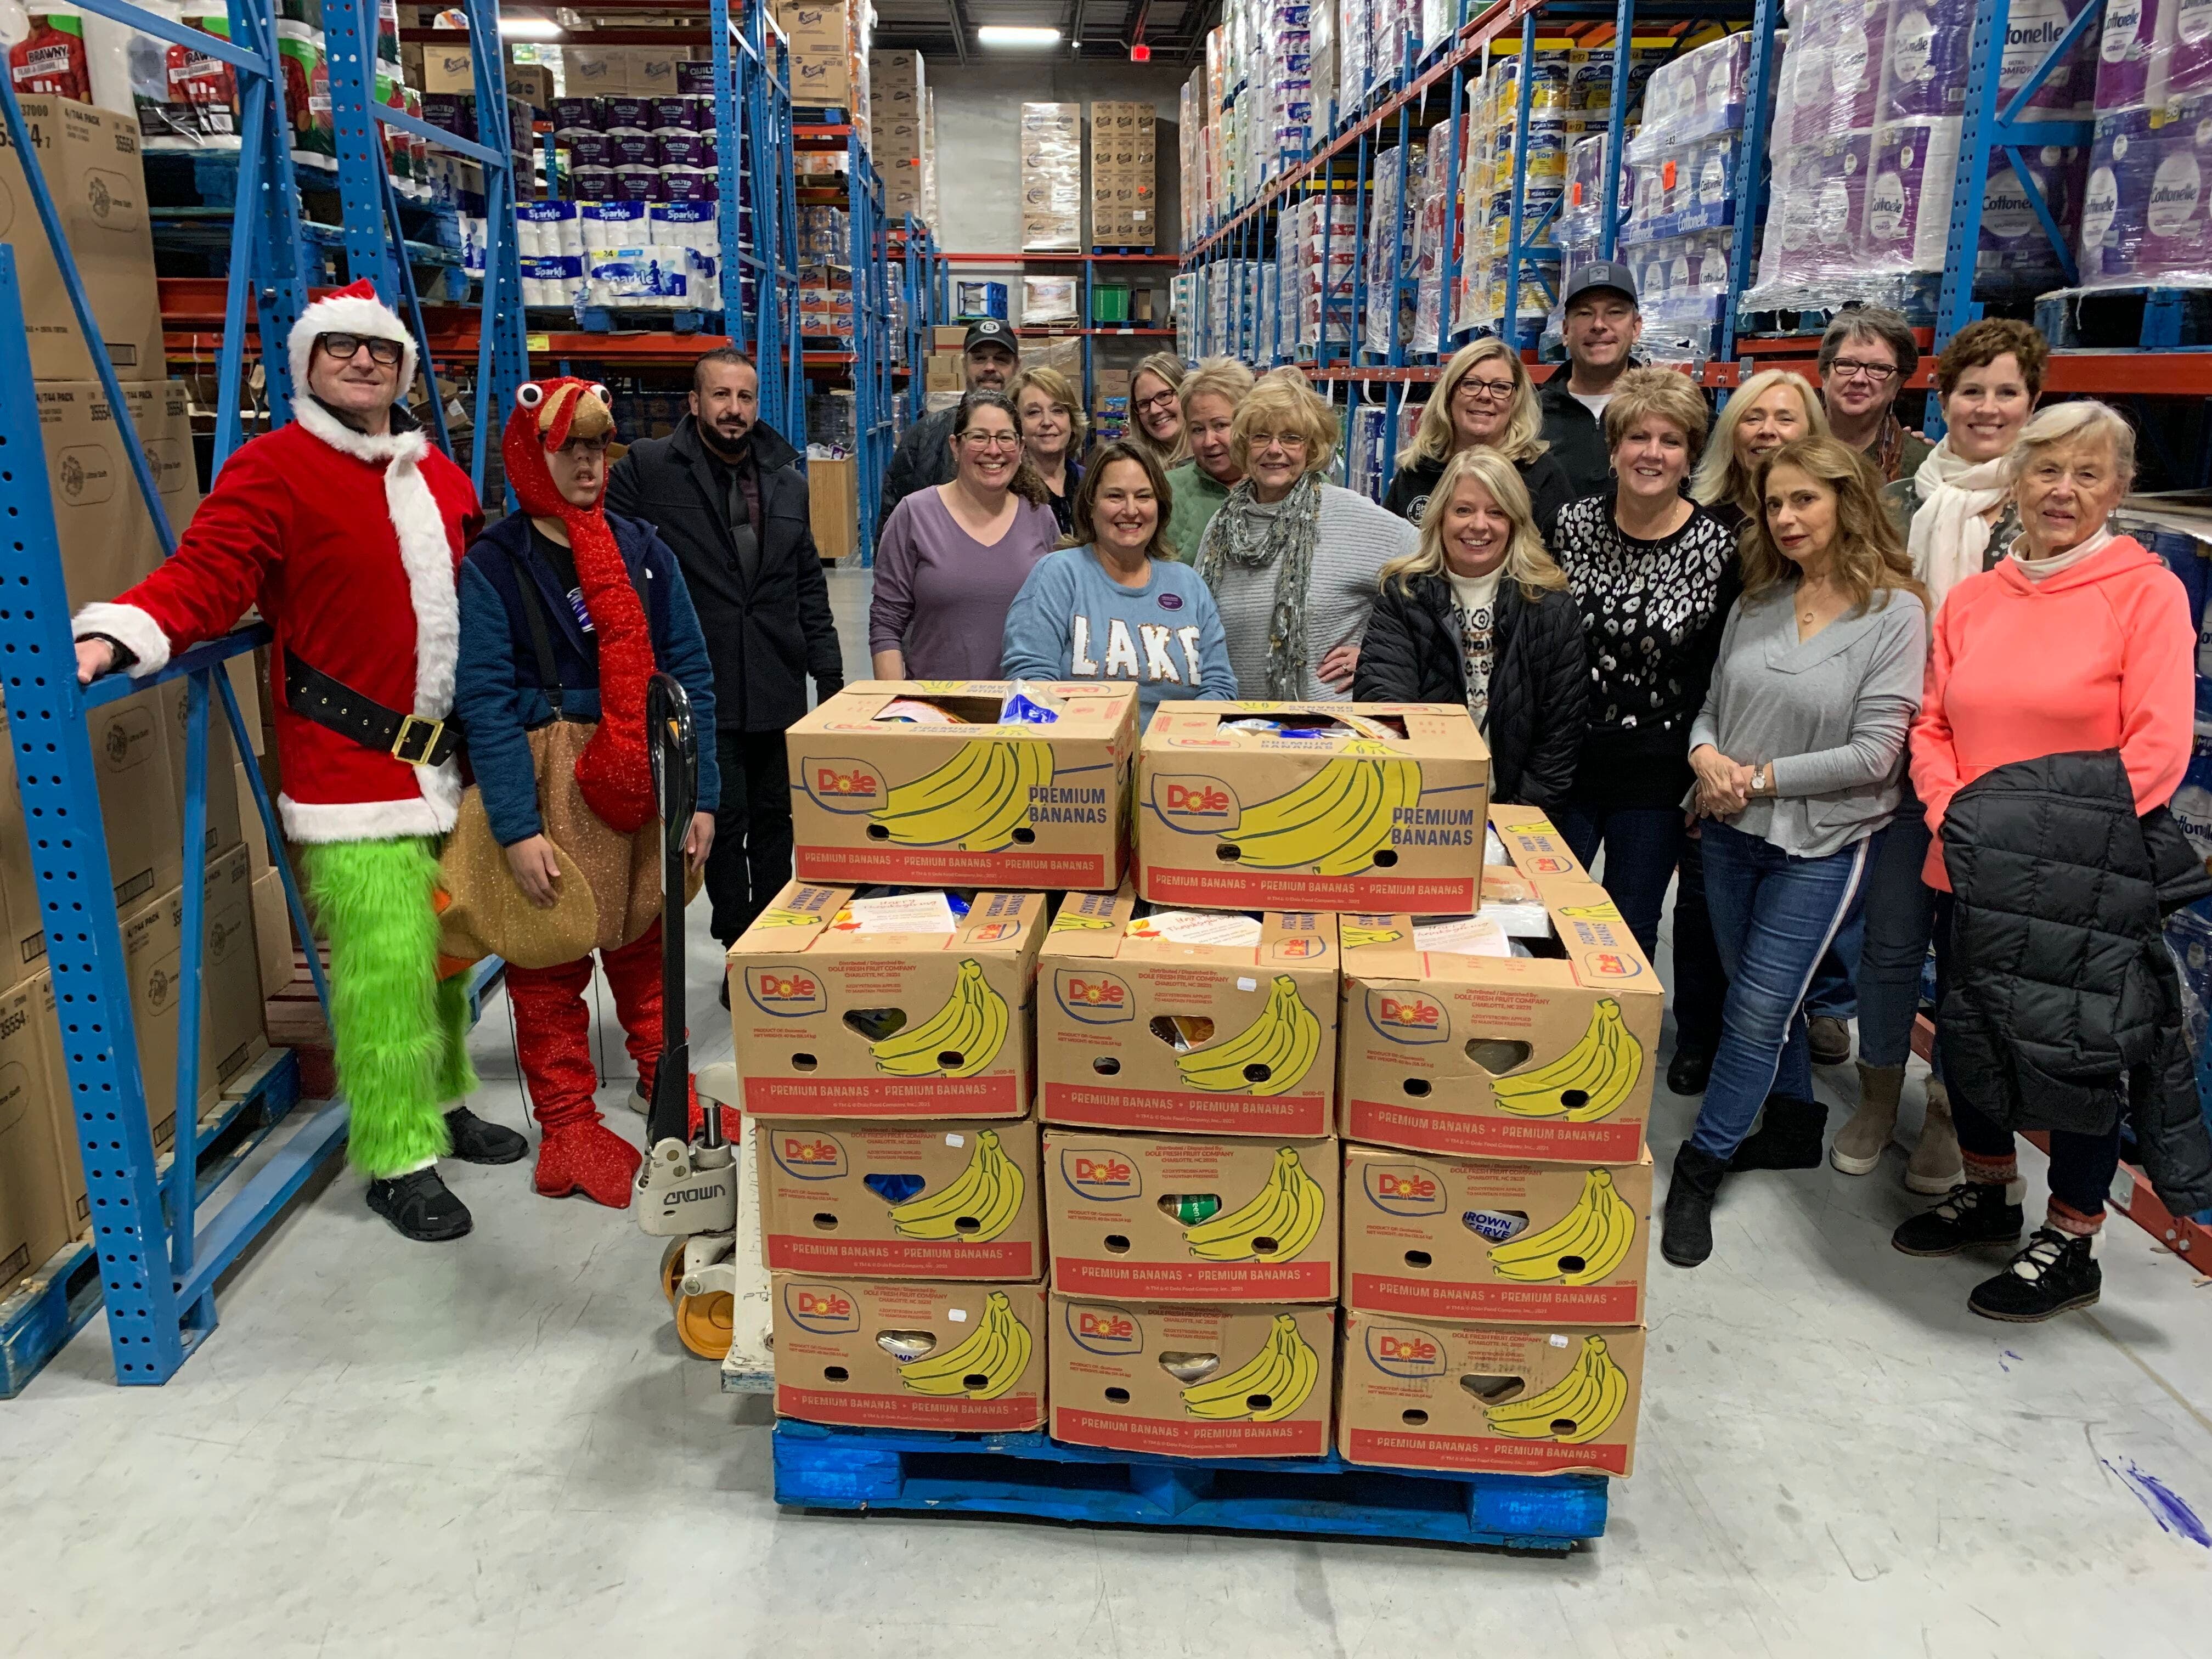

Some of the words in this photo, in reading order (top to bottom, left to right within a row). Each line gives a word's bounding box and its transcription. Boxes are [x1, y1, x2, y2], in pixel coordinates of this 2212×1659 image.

[2005, 21, 2064, 45] tonelle
[29, 46, 67, 63] BRAWNY
[528, 208, 561, 219] Sparkle
[599, 208, 630, 219] Sparkle
[667, 209, 699, 219] Sparkle
[1982, 196, 2033, 211] Cottone
[1678, 208, 1708, 233] Cottonelle
[534, 267, 566, 277] Sparkle
[1070, 614, 1201, 687] LAKE
[818, 769, 877, 794] Dole
[1029, 787, 1105, 804] PREMIUM
[1167, 785, 1229, 811] Dole
[1029, 806, 1107, 823] BANANAS
[1393, 807, 1474, 826] PREMIUM
[1391, 828, 1473, 846] BANANAS
[805, 853, 845, 864] PREMIUM
[849, 854, 890, 865] BANANAS
[904, 856, 946, 867] PREMIUM
[949, 857, 991, 868] BANANAS
[1006, 859, 1048, 870] PREMIUM
[1051, 860, 1094, 871] BANANAS
[1156, 874, 1198, 887] PREMIUM
[1201, 877, 1246, 888] BANANAS
[1261, 880, 1305, 891] PREMIUM
[1308, 881, 1355, 893] BANANAS
[1369, 884, 1414, 895] PREMIUM
[1418, 884, 1463, 895] BANANAS
[760, 975, 815, 997] Dole
[1069, 979, 1124, 1002] Dole
[1381, 998, 1439, 1024] Dole
[771, 1085, 817, 1096] PREMIUM
[820, 1085, 869, 1096] BANANAS
[885, 1085, 933, 1096] PREMIUM
[937, 1084, 987, 1095] BANANAS
[1071, 1093, 1119, 1106] PREMIUM
[1123, 1097, 1173, 1109] BANANAS
[1189, 1100, 1238, 1113] PREMIUM
[1243, 1102, 1294, 1115] BANANAS
[1379, 1111, 1429, 1128] PREMIUM
[1432, 1118, 1485, 1135] BANANAS
[1502, 1126, 1554, 1139] PREMIUM
[1558, 1128, 1610, 1142] BANANAS
[785, 1138, 837, 1161] Dole
[1076, 1159, 1131, 1182] Dole
[1379, 1174, 1436, 1198] Dole
[1469, 1222, 1510, 1239] ERVE
[793, 1243, 838, 1256] PREMIUM
[841, 1246, 889, 1257] BANANAS
[904, 1248, 951, 1259] PREMIUM
[954, 1248, 1003, 1259] BANANAS
[1082, 1267, 1129, 1279] PREMIUM
[1132, 1269, 1182, 1280] BANANAS
[1198, 1270, 1248, 1280] PREMIUM
[1250, 1269, 1300, 1280] BANANAS
[1380, 1283, 1429, 1297] PREMIUM
[1433, 1288, 1485, 1301] BANANAS
[1501, 1291, 1551, 1304] PREMIUM
[1555, 1293, 1607, 1304] BANANAS
[798, 1293, 850, 1316] Dole
[1080, 1313, 1133, 1336] Dole
[1380, 1336, 1436, 1361] Dole
[802, 1396, 847, 1408] PREMIUM
[850, 1398, 898, 1410] BANANAS
[912, 1402, 960, 1413] PREMIUM
[962, 1403, 1009, 1414] BANANAS
[1082, 1418, 1128, 1431] PREMIUM
[1131, 1424, 1179, 1436] BANANAS
[1194, 1428, 1242, 1438] PREMIUM
[1244, 1427, 1293, 1438] BANANAS
[1378, 1437, 1425, 1450] PREMIUM
[1429, 1441, 1478, 1452] BANANAS
[1494, 1444, 1543, 1457] PREMIUM
[1546, 1447, 1596, 1459] BANANAS
